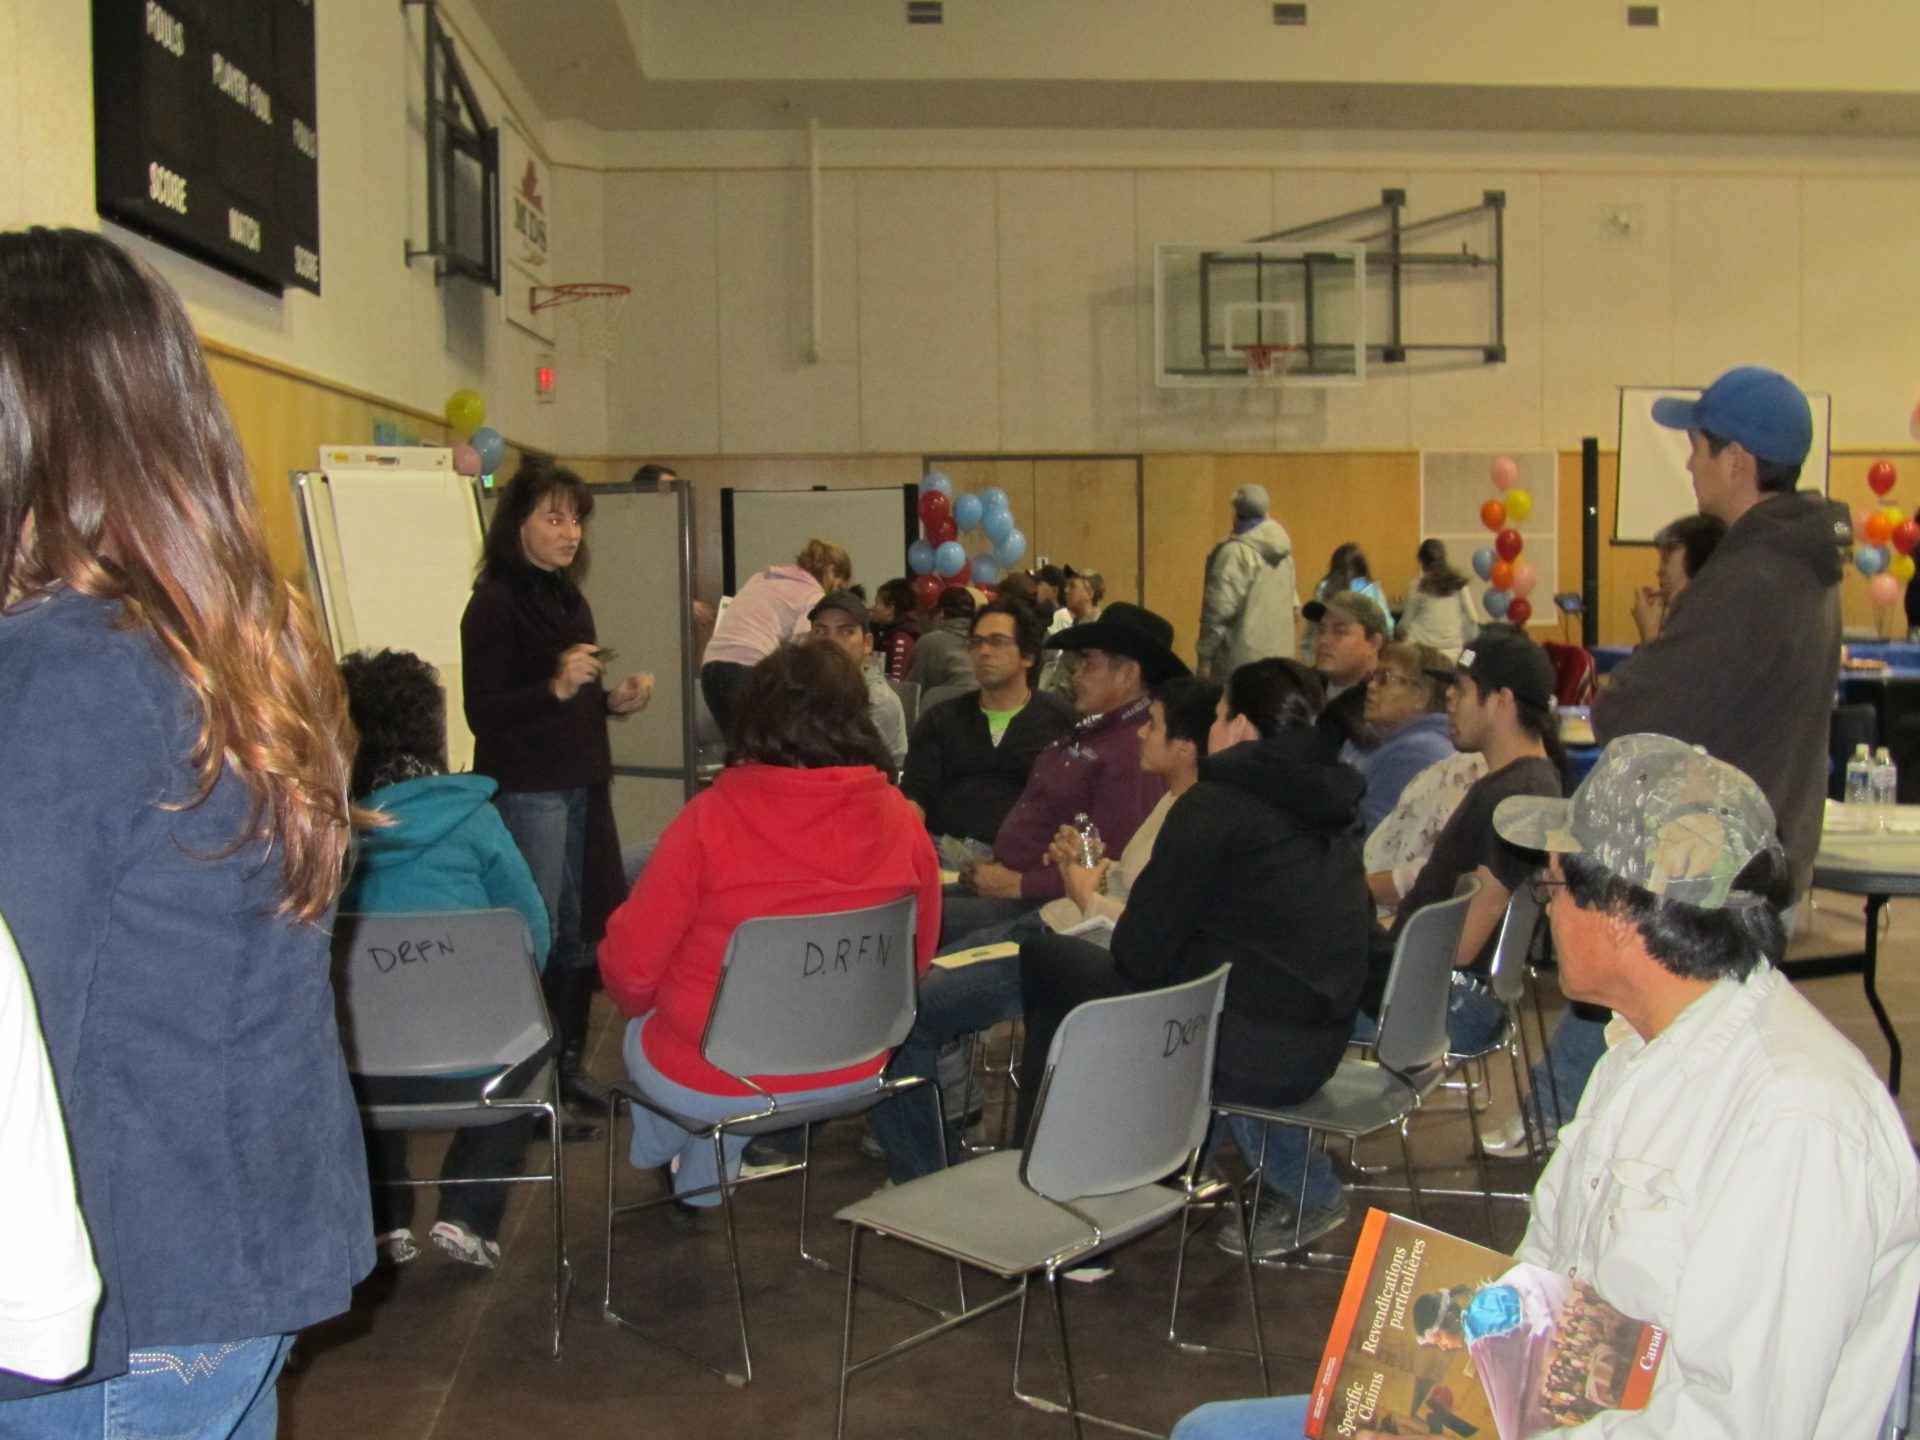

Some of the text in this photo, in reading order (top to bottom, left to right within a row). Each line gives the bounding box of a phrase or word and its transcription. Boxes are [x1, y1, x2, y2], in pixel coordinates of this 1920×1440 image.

[146, 1, 185, 57] FOULS
[212, 52, 248, 106] PLAYER
[149, 161, 188, 214] SCORE
[367, 935, 455, 974] DRFN
[1361, 1246, 1407, 1354] Revendications
[1390, 1238, 1426, 1331] particulières
[1640, 1324, 1664, 1370] Canad
[1337, 1382, 1364, 1437] Specific
[1358, 1371, 1384, 1420] Claims
